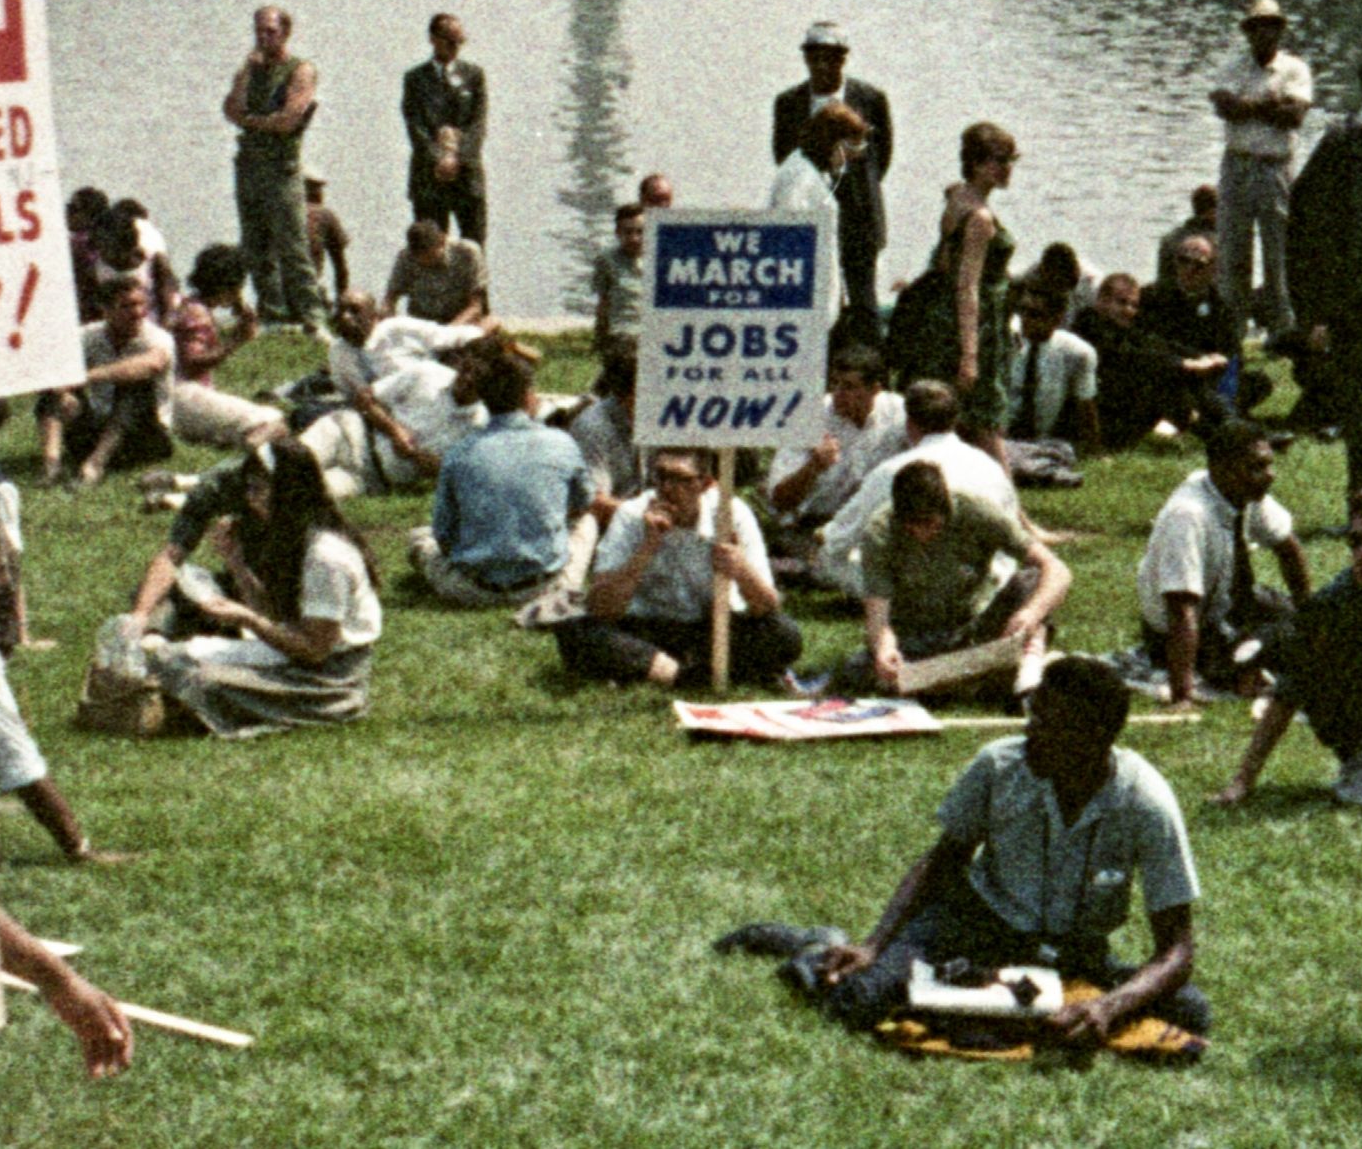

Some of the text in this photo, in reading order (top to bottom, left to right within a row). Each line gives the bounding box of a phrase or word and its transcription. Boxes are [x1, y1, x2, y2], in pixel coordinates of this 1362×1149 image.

[713, 230, 762, 254] WE
[666, 258, 804, 286] MARCH
[709, 289, 762, 305] FOR
[663, 322, 800, 359] JOBS
[665, 366, 794, 382] FOR ALL
[657, 390, 803, 429] NOW!
